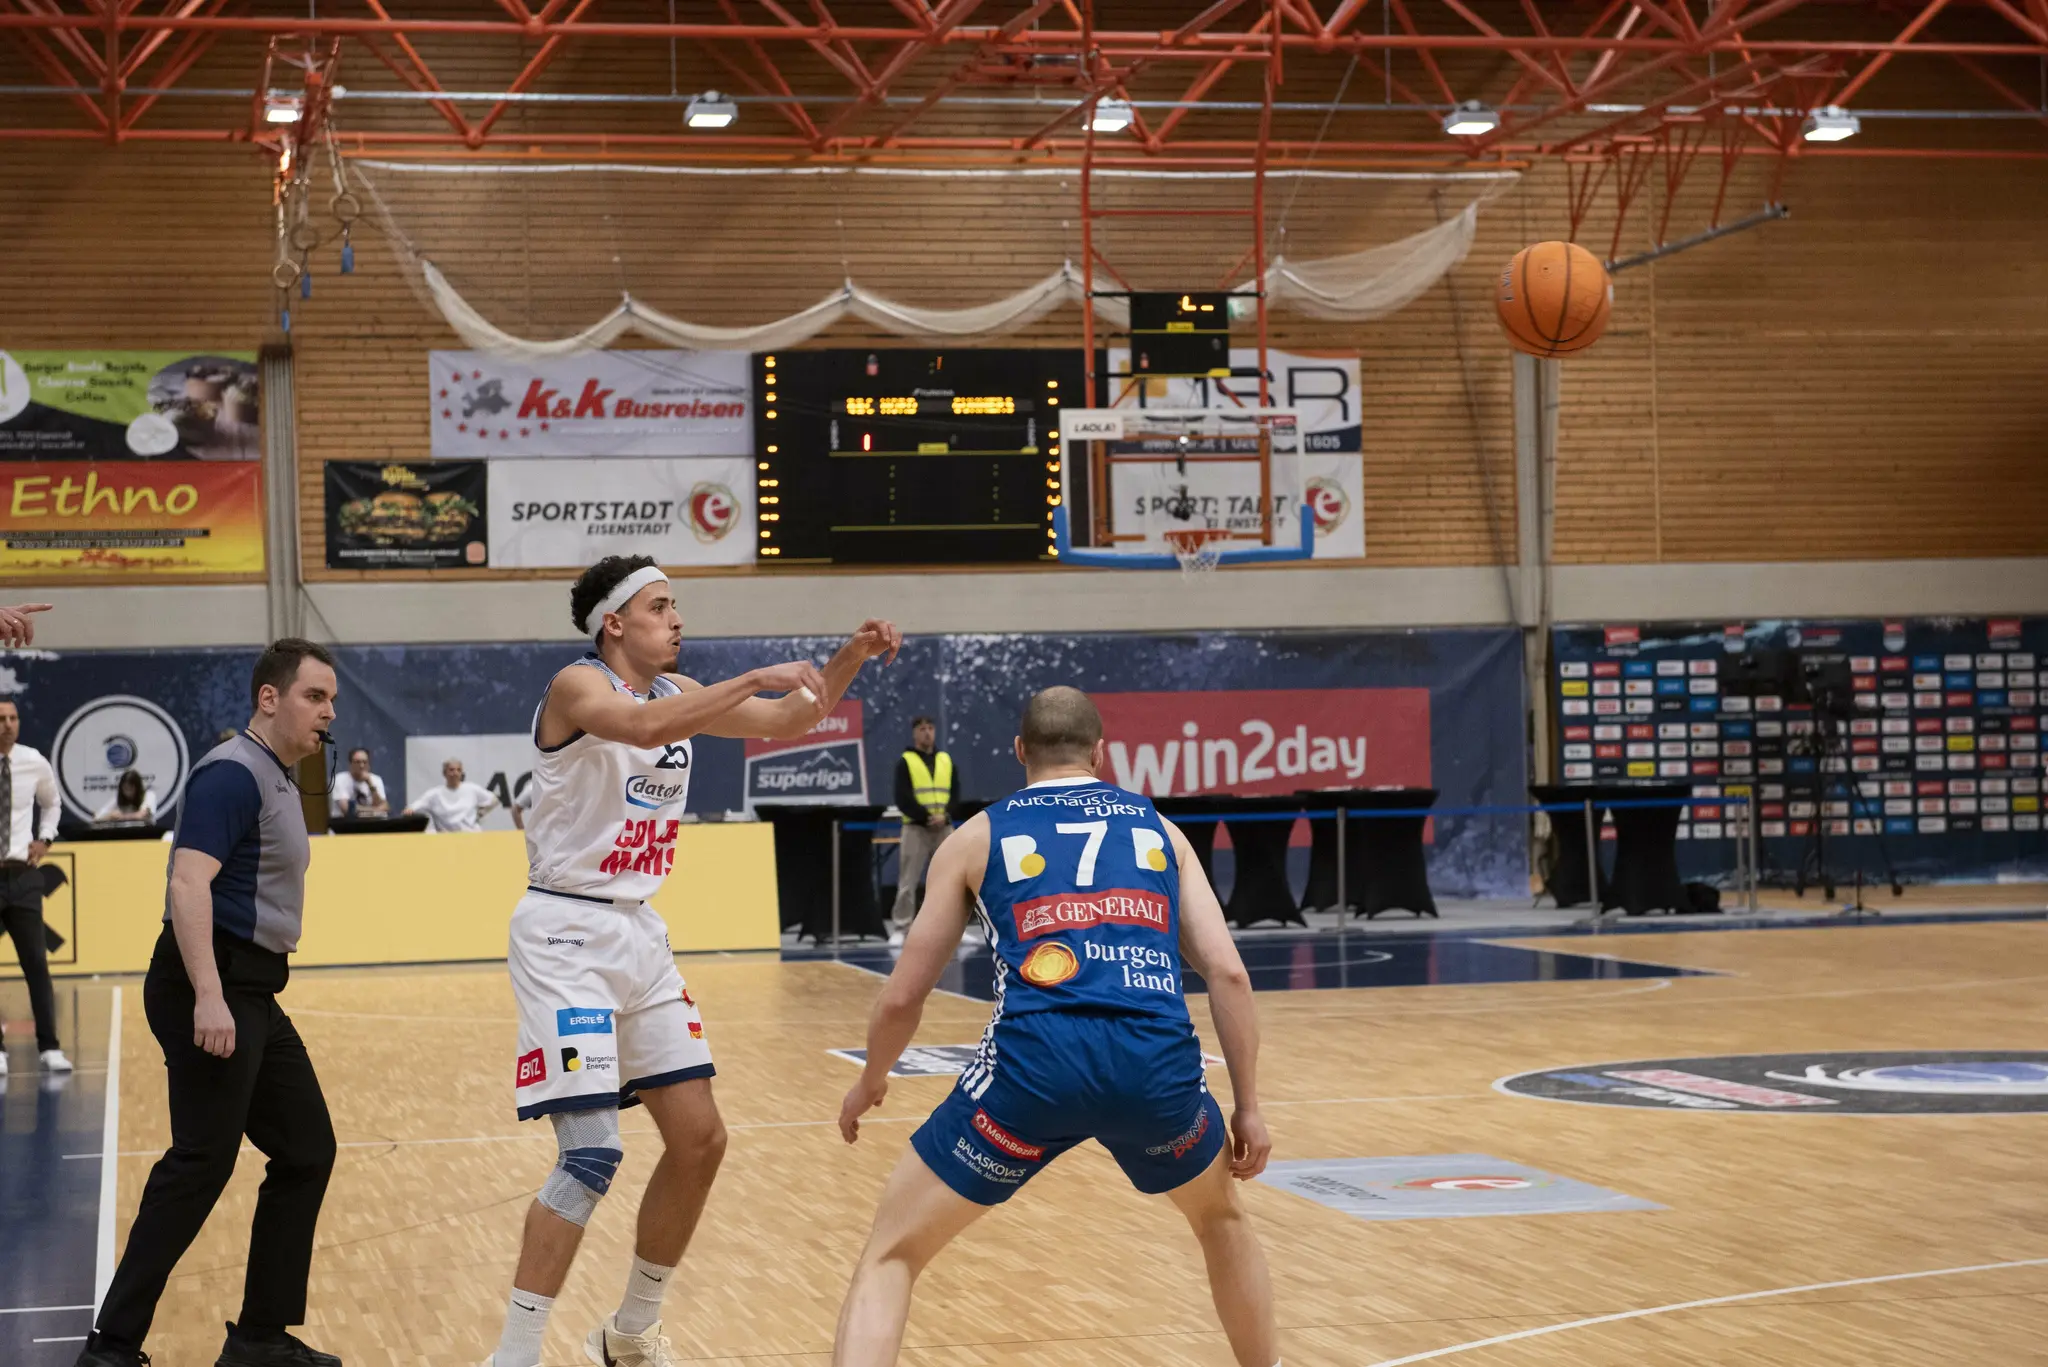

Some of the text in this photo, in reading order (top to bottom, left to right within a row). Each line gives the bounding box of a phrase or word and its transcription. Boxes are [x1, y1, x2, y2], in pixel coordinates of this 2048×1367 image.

[517, 378, 745, 419] K&K Busreisen
[10, 471, 199, 518] Ethno
[512, 501, 674, 521] SPORTSTADT
[587, 523, 672, 536] EISENSTADT
[1108, 720, 1367, 798] win2day
[757, 769, 855, 791] superliga
[1083, 803, 1147, 818] FÜRST
[1055, 820, 1108, 887] 7
[1056, 895, 1164, 924] GENERALI
[547, 936, 585, 947] SPALDING
[1084, 940, 1172, 970] burgen
[1122, 965, 1177, 995] land
[570, 1016, 596, 1026] ERSTE
[985, 1124, 1041, 1157] MeinBezirk
